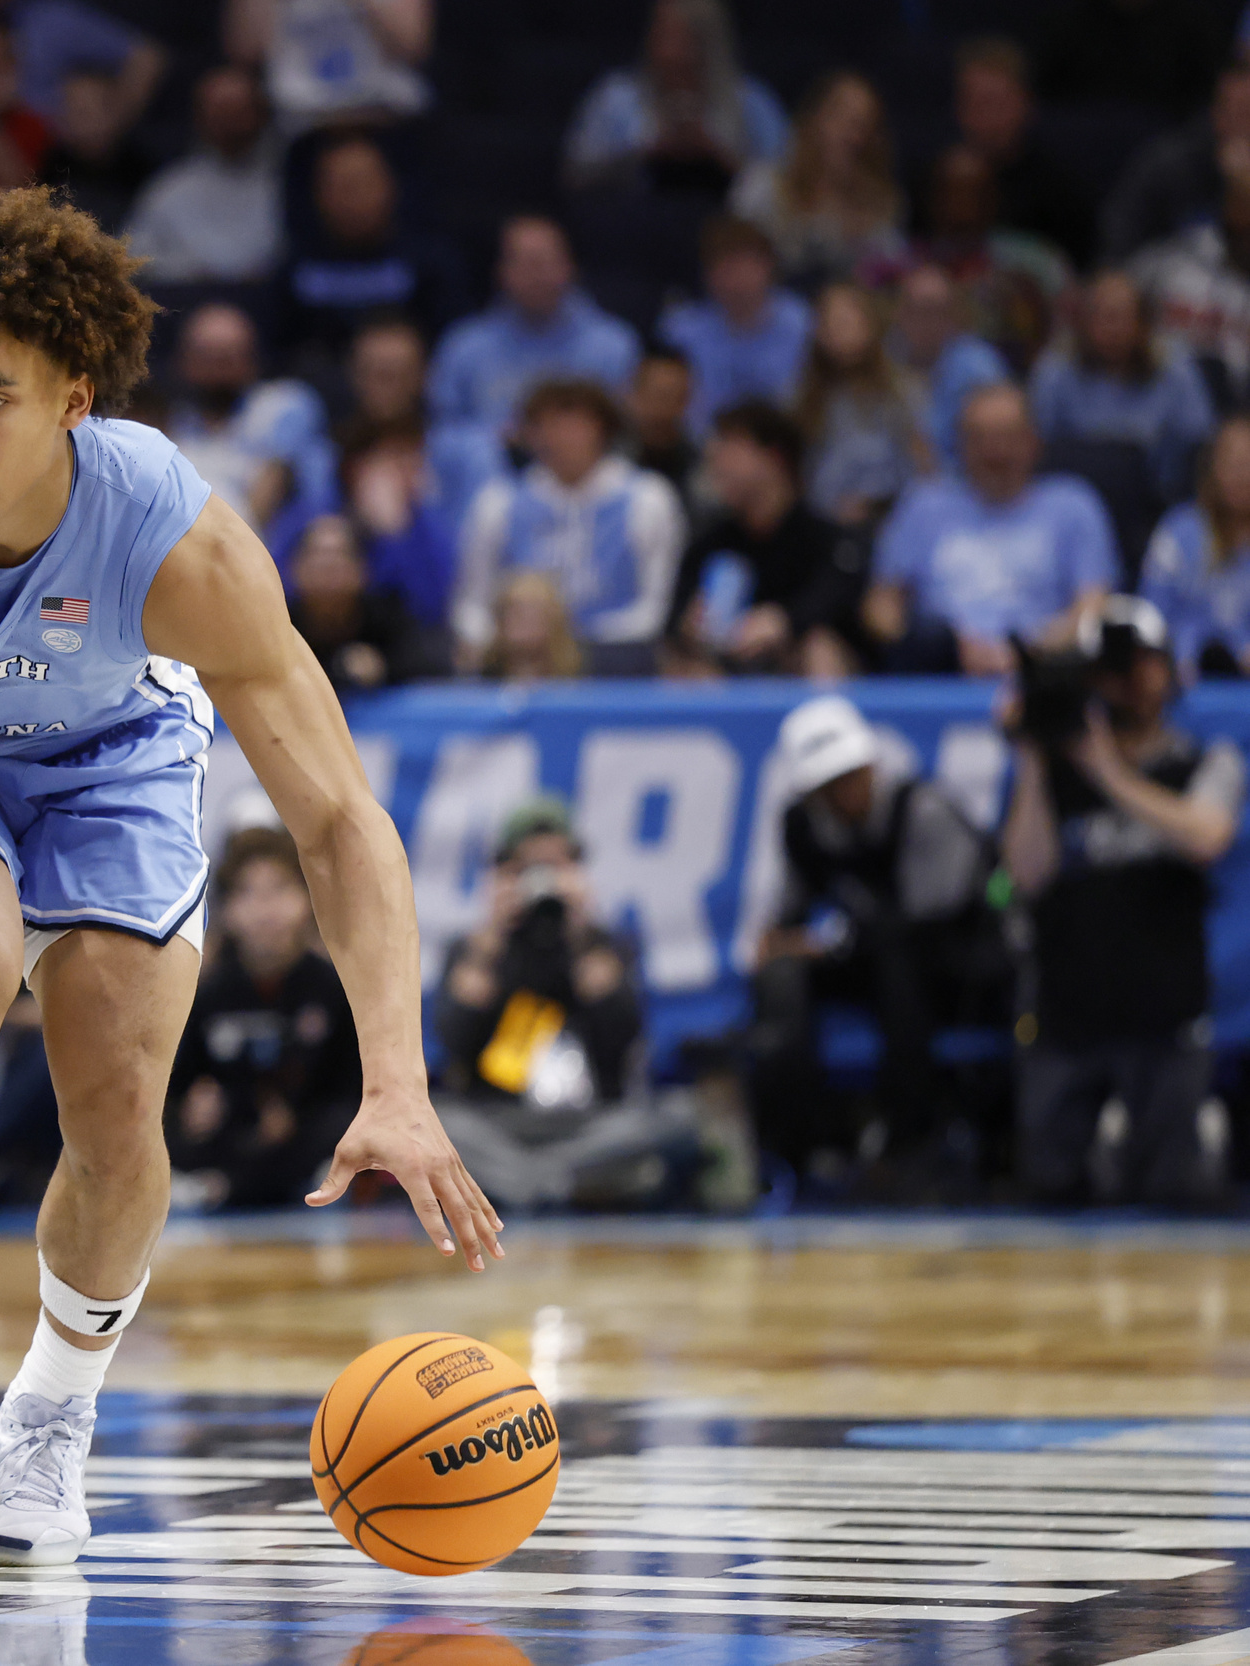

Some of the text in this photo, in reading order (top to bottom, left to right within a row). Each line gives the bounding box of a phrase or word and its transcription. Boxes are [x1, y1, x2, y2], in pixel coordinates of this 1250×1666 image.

[86, 1309, 122, 1333] 7
[417, 1352, 470, 1387] MADNESS
[443, 1360, 484, 1386] MARCH
[475, 1415, 496, 1430] NXT
[424, 1402, 557, 1477] Wilson
